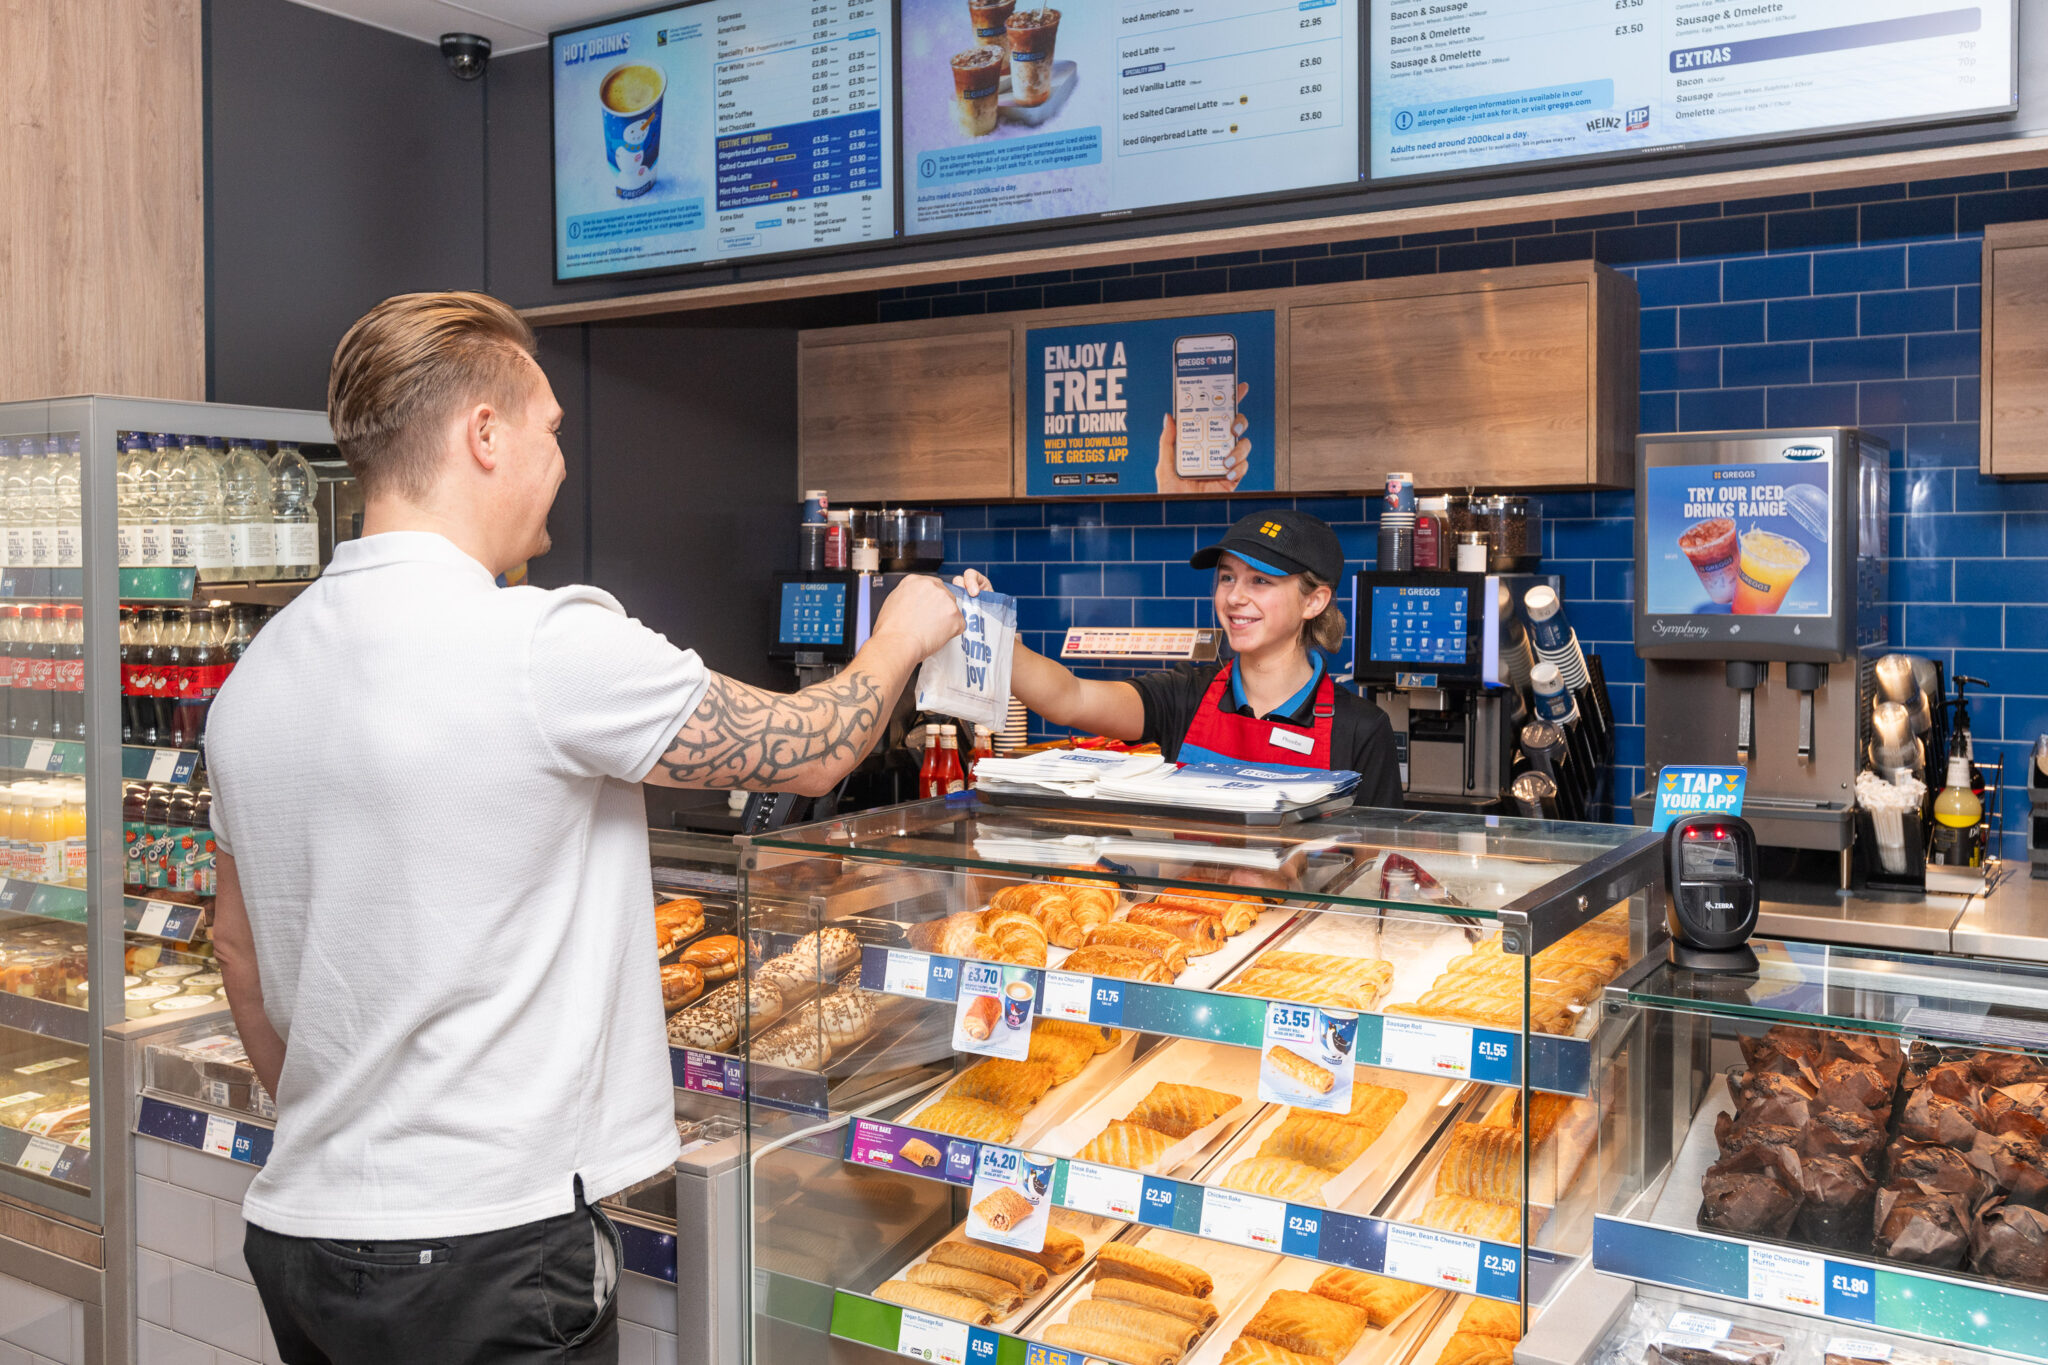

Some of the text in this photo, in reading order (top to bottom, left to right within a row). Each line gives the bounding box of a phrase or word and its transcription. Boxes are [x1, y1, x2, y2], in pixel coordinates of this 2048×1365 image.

[1122, 7, 1180, 25] Iced Americano
[1390, 2, 1468, 21] Bacon & Sausage
[1675, 2, 1784, 27] Sausage & Omelette
[1299, 17, 1322, 29] £2.95
[1615, 23, 1644, 37] £3.50
[1390, 26, 1471, 45] Bacon & Omelette
[562, 32, 631, 64] HOT DRINKS
[1122, 45, 1160, 59] Iced Latte
[1390, 49, 1482, 70] Sausage & Omelette
[1675, 46, 1732, 69] EXTRAS
[1122, 78, 1186, 96] Iced Vanilla Latte
[1676, 76, 1704, 87] Bacon
[718, 89, 733, 98] Latte
[1676, 91, 1714, 103] Sausage
[718, 101, 736, 110] Mocha
[1122, 99, 1218, 121] Iced Salted Caramel Latte
[1418, 110, 1427, 118] All
[1437, 107, 1448, 115] our
[1450, 103, 1477, 113] allergen
[1479, 98, 1520, 110] information
[1529, 93, 1560, 103] available
[1571, 90, 1583, 98] our
[1418, 117, 1445, 127] allergen
[1447, 114, 1465, 123] guide
[1472, 112, 1485, 120] just
[1487, 110, 1499, 118] ask
[1501, 108, 1510, 116] for
[1522, 106, 1528, 114] or
[1531, 104, 1546, 112] visit
[1548, 98, 1591, 110] greggs.com
[1627, 109, 1648, 125] HP
[1675, 107, 1715, 120] Omelette
[718, 122, 756, 133] Hot Chocolate
[1586, 117, 1621, 132] HEINZ
[1122, 127, 1207, 146] Iced Gingerbread Latte
[1391, 144, 1415, 155] Adults
[1417, 141, 1436, 151] need
[1438, 139, 1466, 149] around
[1467, 132, 1504, 144] 2000kcal
[1512, 130, 1529, 141] day.
[917, 193, 935, 203] Adults
[936, 192, 951, 201] need
[952, 189, 972, 199] around
[1044, 341, 1127, 371] ENJOY A
[1178, 357, 1205, 367] GREGGS
[1218, 355, 1232, 365] TAP
[1044, 367, 1127, 413] FREE
[1044, 411, 1127, 435] HOT DRINK
[1044, 436, 1128, 450] WHEN YOU DOWNLOAD
[1044, 448, 1128, 464] THE GREGGS APP
[1722, 471, 1755, 479] GREGGS
[1688, 485, 1784, 503] TRY OUR ICED
[1684, 501, 1787, 518] DRINKS RANGE
[172, 537, 185, 545] STILL
[172, 549, 188, 557] WATER
[1705, 556, 1734, 572] GREGGS
[1741, 573, 1770, 592] GREGGS
[1407, 589, 1440, 597] GREGGS
[966, 658, 986, 692] joy
[1681, 773, 1723, 793] TAP
[1662, 794, 1737, 809] YOUR APP
[148, 832, 168, 862] Oasis
[1714, 902, 1734, 910] ZEBRA
[933, 966, 953, 979] £1.70
[968, 967, 998, 984] £3.70
[1097, 989, 1119, 1002] £1.75
[1273, 1009, 1310, 1028] £3.55
[1386, 1020, 1410, 1029] Sausage
[1478, 1041, 1508, 1057] £1.55
[859, 1122, 892, 1135] FESTIVE BAKE
[236, 1137, 250, 1150] £1.75
[951, 1152, 971, 1165] £2.50
[983, 1151, 1017, 1171] £4.20
[1071, 1164, 1084, 1172] Steak
[1146, 1188, 1172, 1204] £2.50
[1207, 1191, 1242, 1202] Chicken Bake
[1289, 1216, 1318, 1233] £2.50
[1391, 1227, 1417, 1237] Sausage,
[1418, 1232, 1433, 1240] Bean
[1440, 1236, 1462, 1246] Cheese
[1463, 1240, 1476, 1248] Melt
[1484, 1255, 1516, 1273] £2.50
[1753, 1250, 1810, 1267] Triple Chocolate
[1753, 1258, 1775, 1267] Muffin
[1832, 1275, 1869, 1294] £1.80
[904, 1313, 917, 1322] Vegan
[918, 1316, 935, 1325] Sausage
[972, 1339, 994, 1355] £1.55
